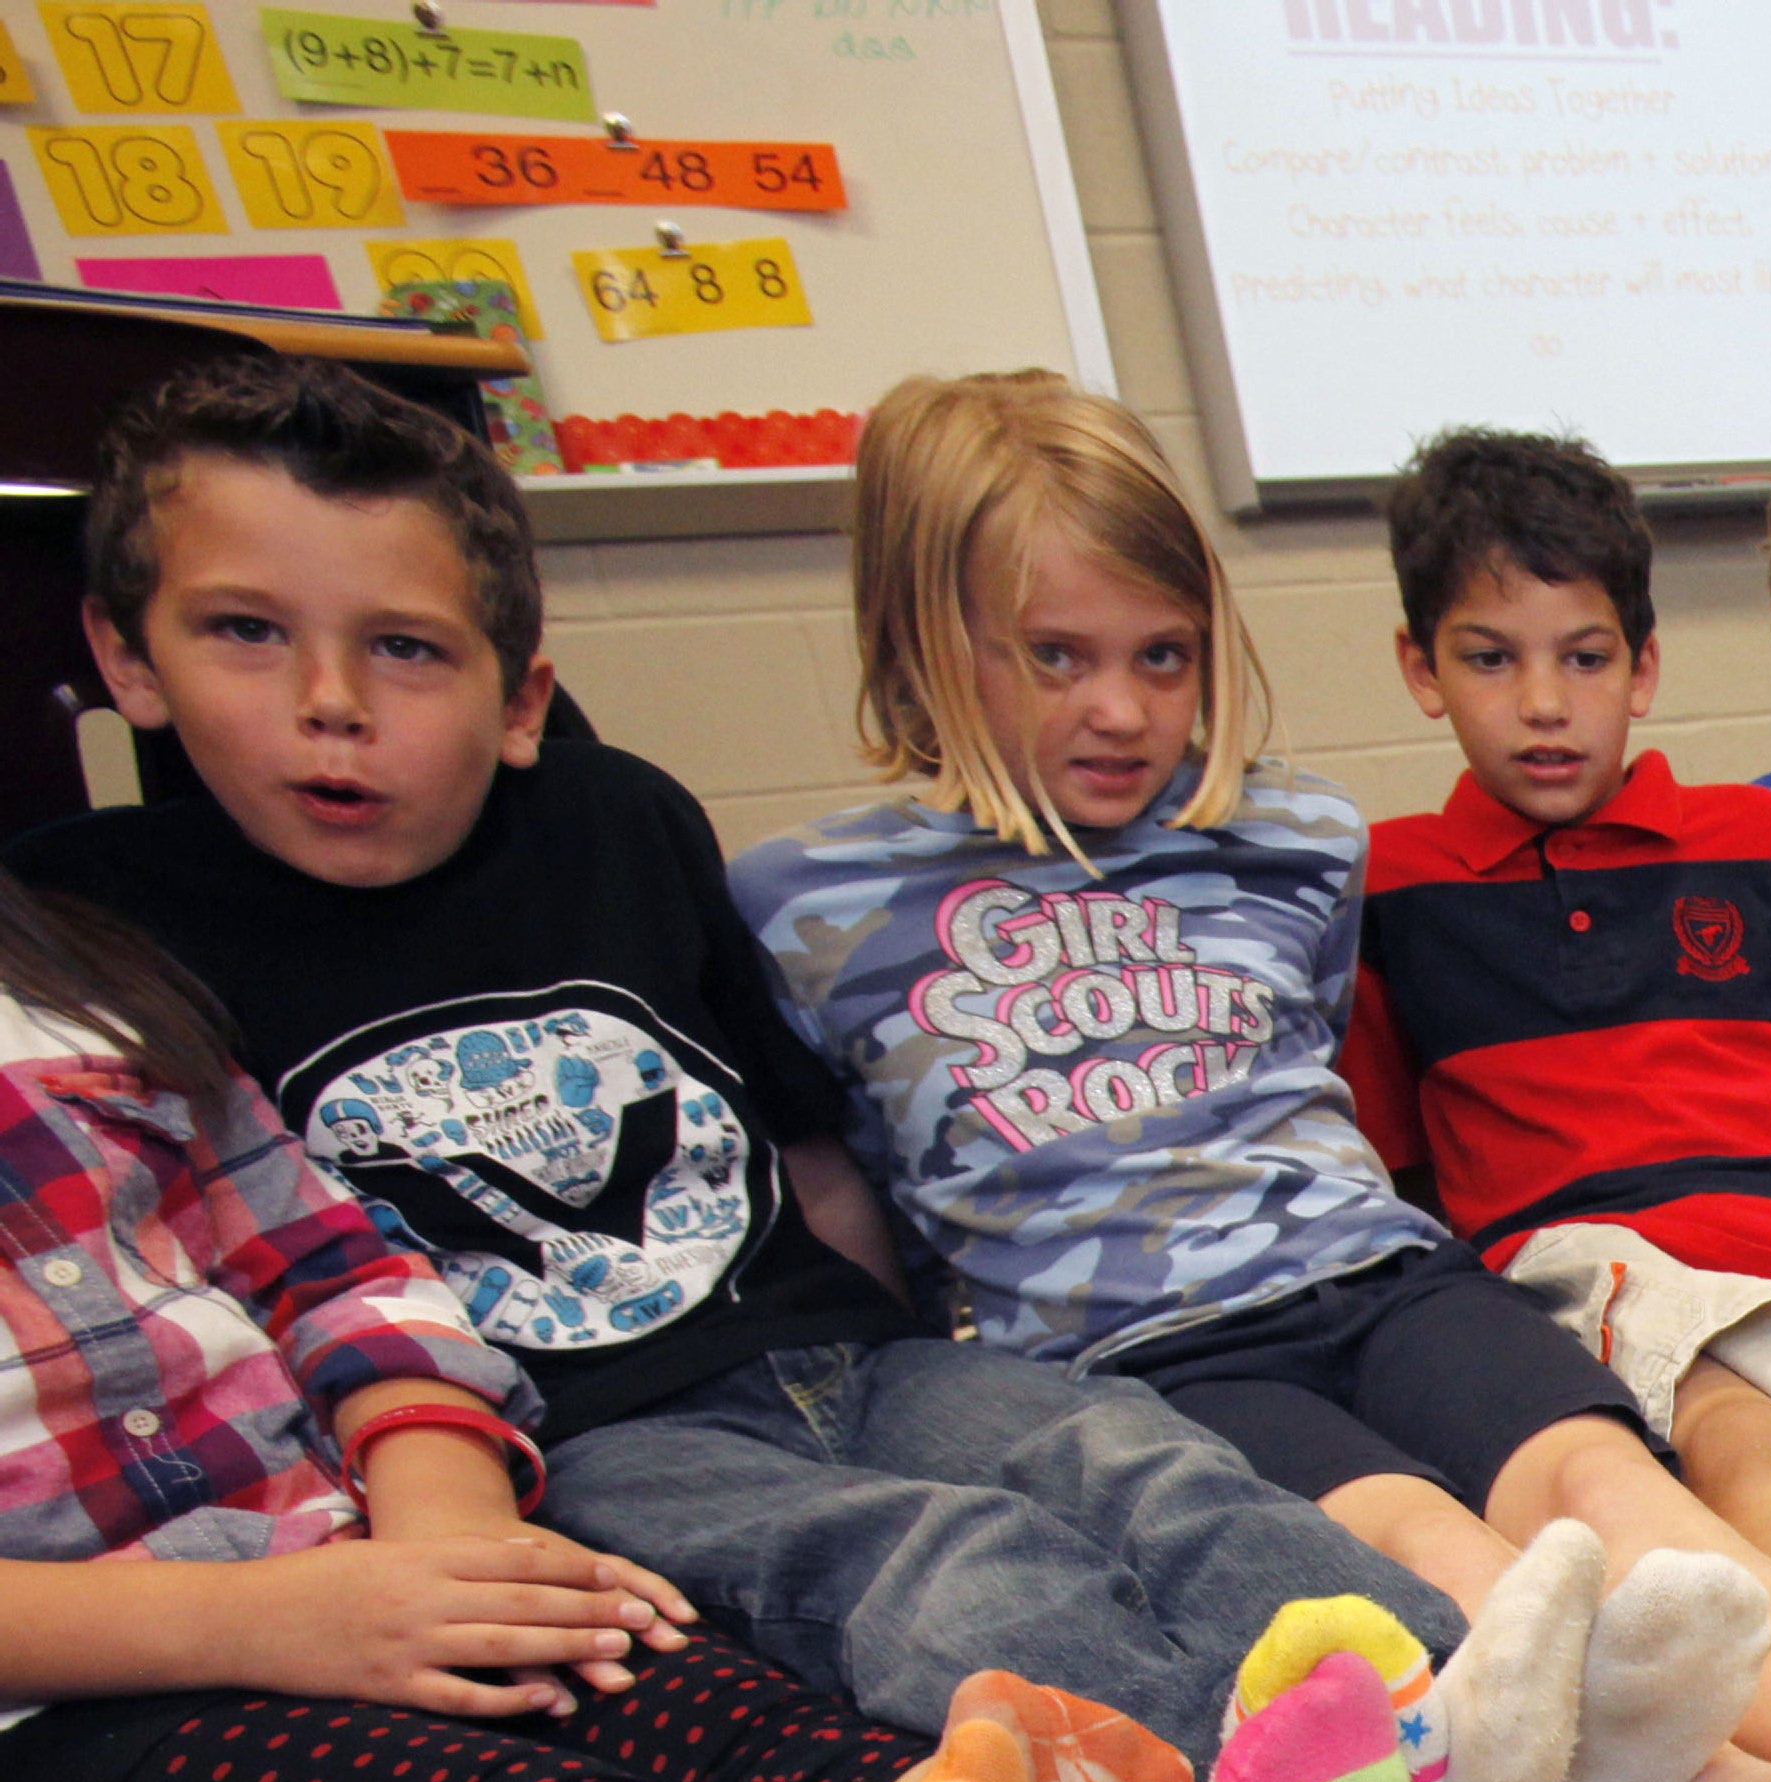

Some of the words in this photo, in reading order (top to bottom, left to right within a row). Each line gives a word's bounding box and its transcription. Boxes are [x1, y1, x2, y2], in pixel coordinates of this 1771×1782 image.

[65, 13, 203, 105] 17
[47, 136, 203, 226] 18
[243, 131, 381, 219] 19
[472, 145, 558, 188] 36
[641, 150, 714, 191] 48
[752, 151, 822, 190] 54
[592, 268, 658, 311] 64
[692, 263, 725, 304] 8
[757, 258, 787, 298] 8
[936, 879, 1197, 985] GIRL
[909, 963, 1275, 1092] SCOUTS
